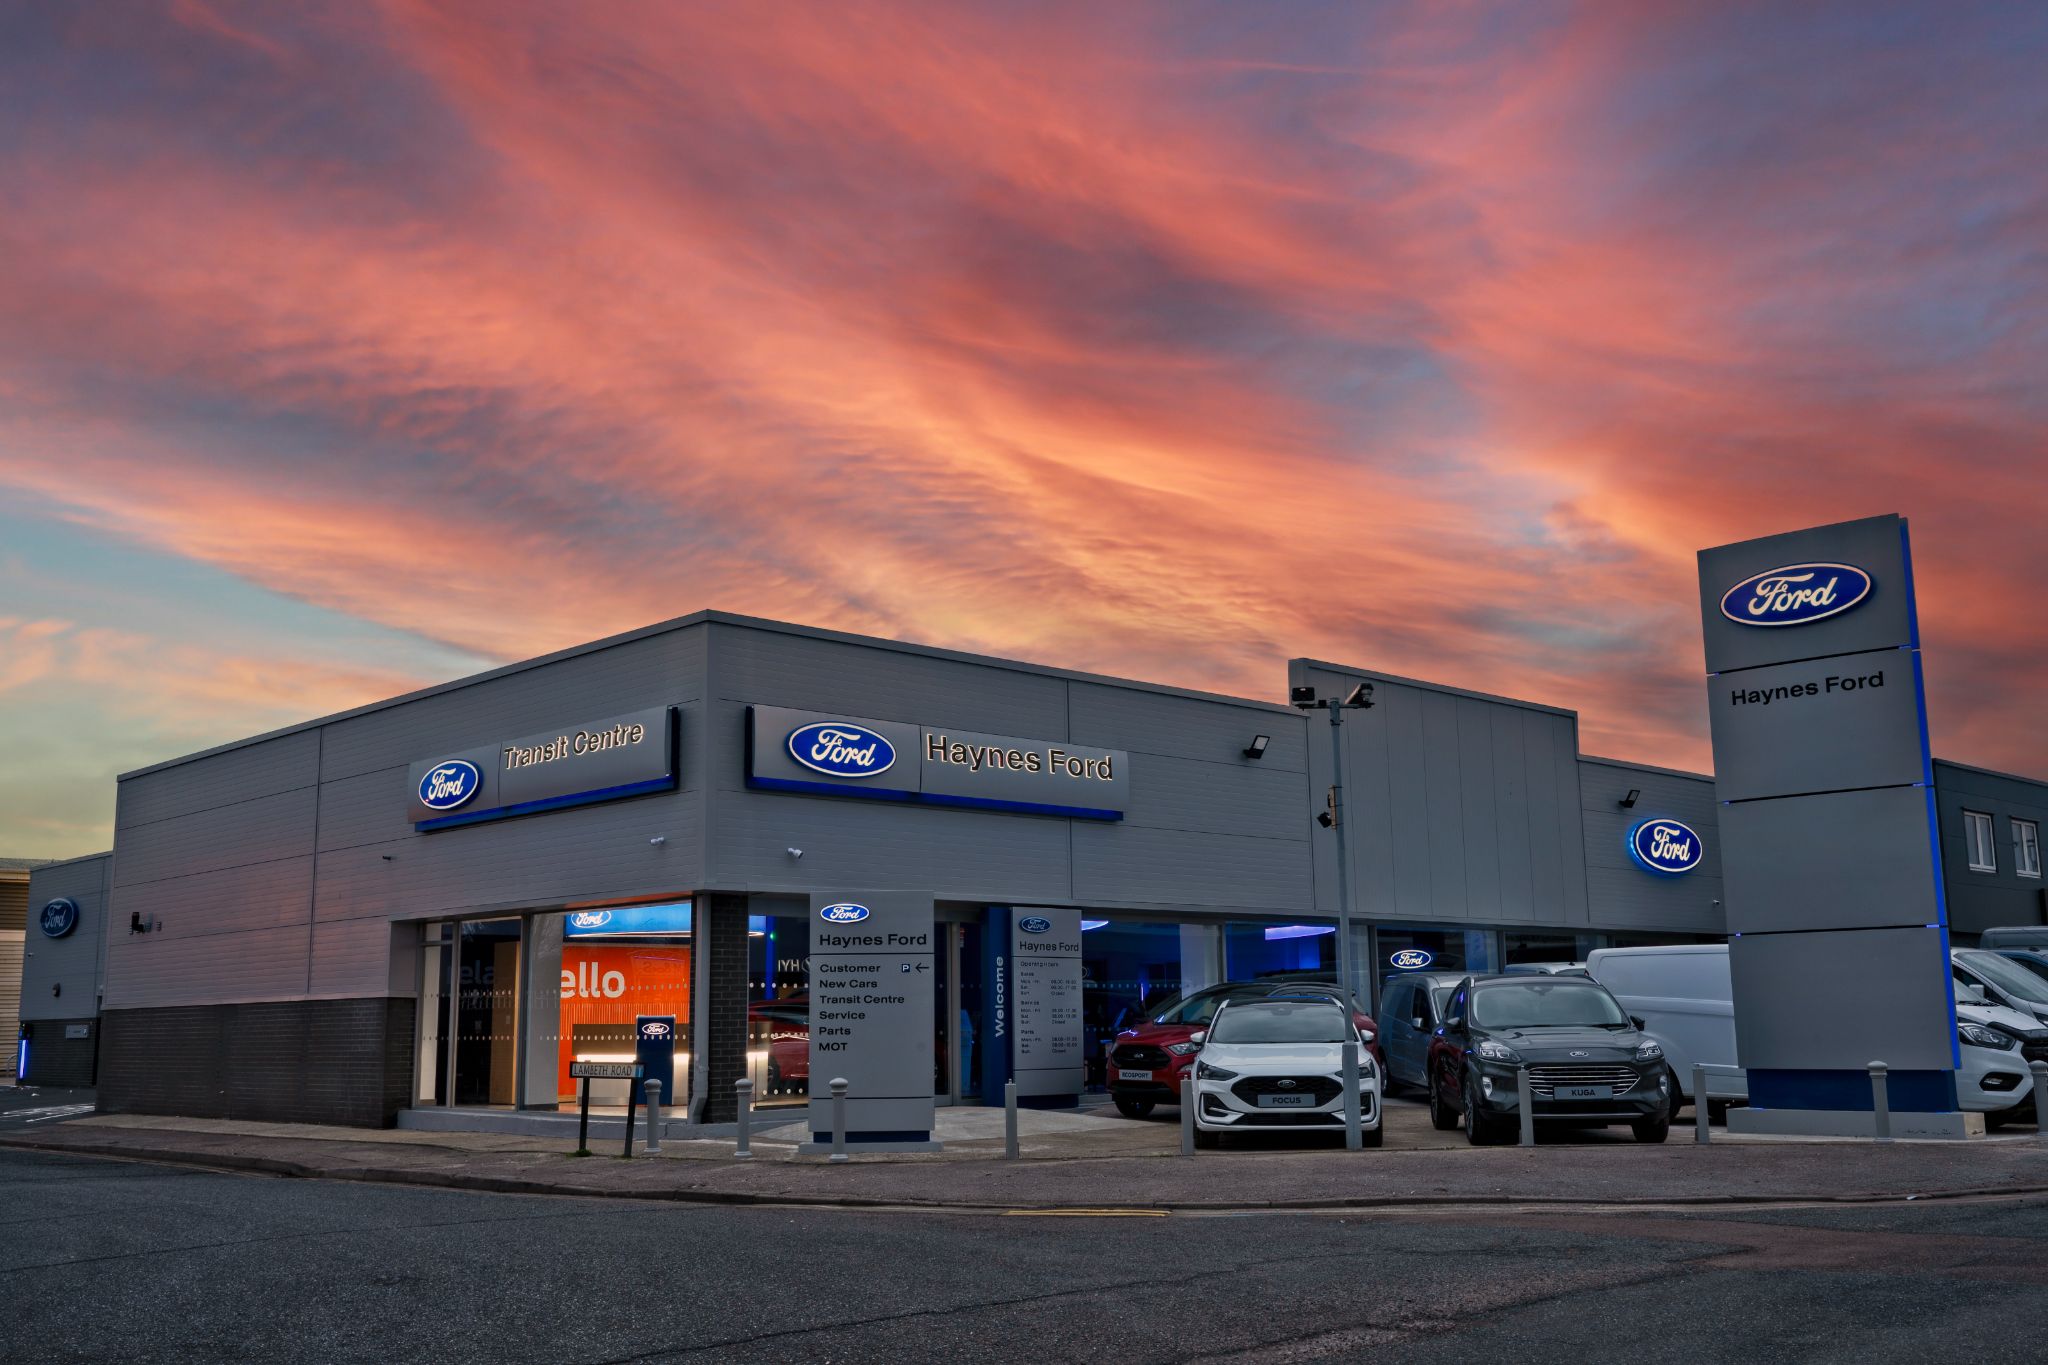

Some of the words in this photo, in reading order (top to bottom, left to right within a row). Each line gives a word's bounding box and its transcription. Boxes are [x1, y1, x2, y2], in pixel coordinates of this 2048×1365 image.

[1748, 572, 1838, 615] Ford
[1731, 681, 1819, 705] Haynes
[1825, 671, 1884, 693] Ford
[504, 735, 569, 770] Transit
[573, 723, 644, 755] Centre
[811, 728, 877, 768] Ford
[926, 733, 1040, 772] Haynes
[1048, 748, 1113, 780] Ford
[428, 767, 466, 800] Ford
[1650, 825, 1691, 862] Ford
[44, 904, 67, 929] Ford
[576, 911, 604, 925] Ford
[829, 906, 860, 920] Ford
[1027, 919, 1045, 930] Ford
[819, 933, 883, 949] Haynes
[888, 933, 927, 946] Ford
[1019, 941, 1057, 952] Haynes
[1059, 942, 1079, 952] Ford
[1398, 952, 1424, 965] Ford
[819, 963, 881, 973] Customer
[819, 979, 846, 988] New
[849, 979, 878, 988] Cars
[819, 995, 861, 1004] Transit
[863, 995, 905, 1004] Centre
[995, 956, 1004, 1038] Welcome
[819, 1011, 866, 1020] Service
[819, 1026, 851, 1036] Parts
[819, 1042, 848, 1051] MOT
[574, 1063, 607, 1076] LAMBETH
[611, 1064, 632, 1076] ROAD
[1571, 1089, 1596, 1097] KUGA
[1272, 1096, 1301, 1104] FOCUS
